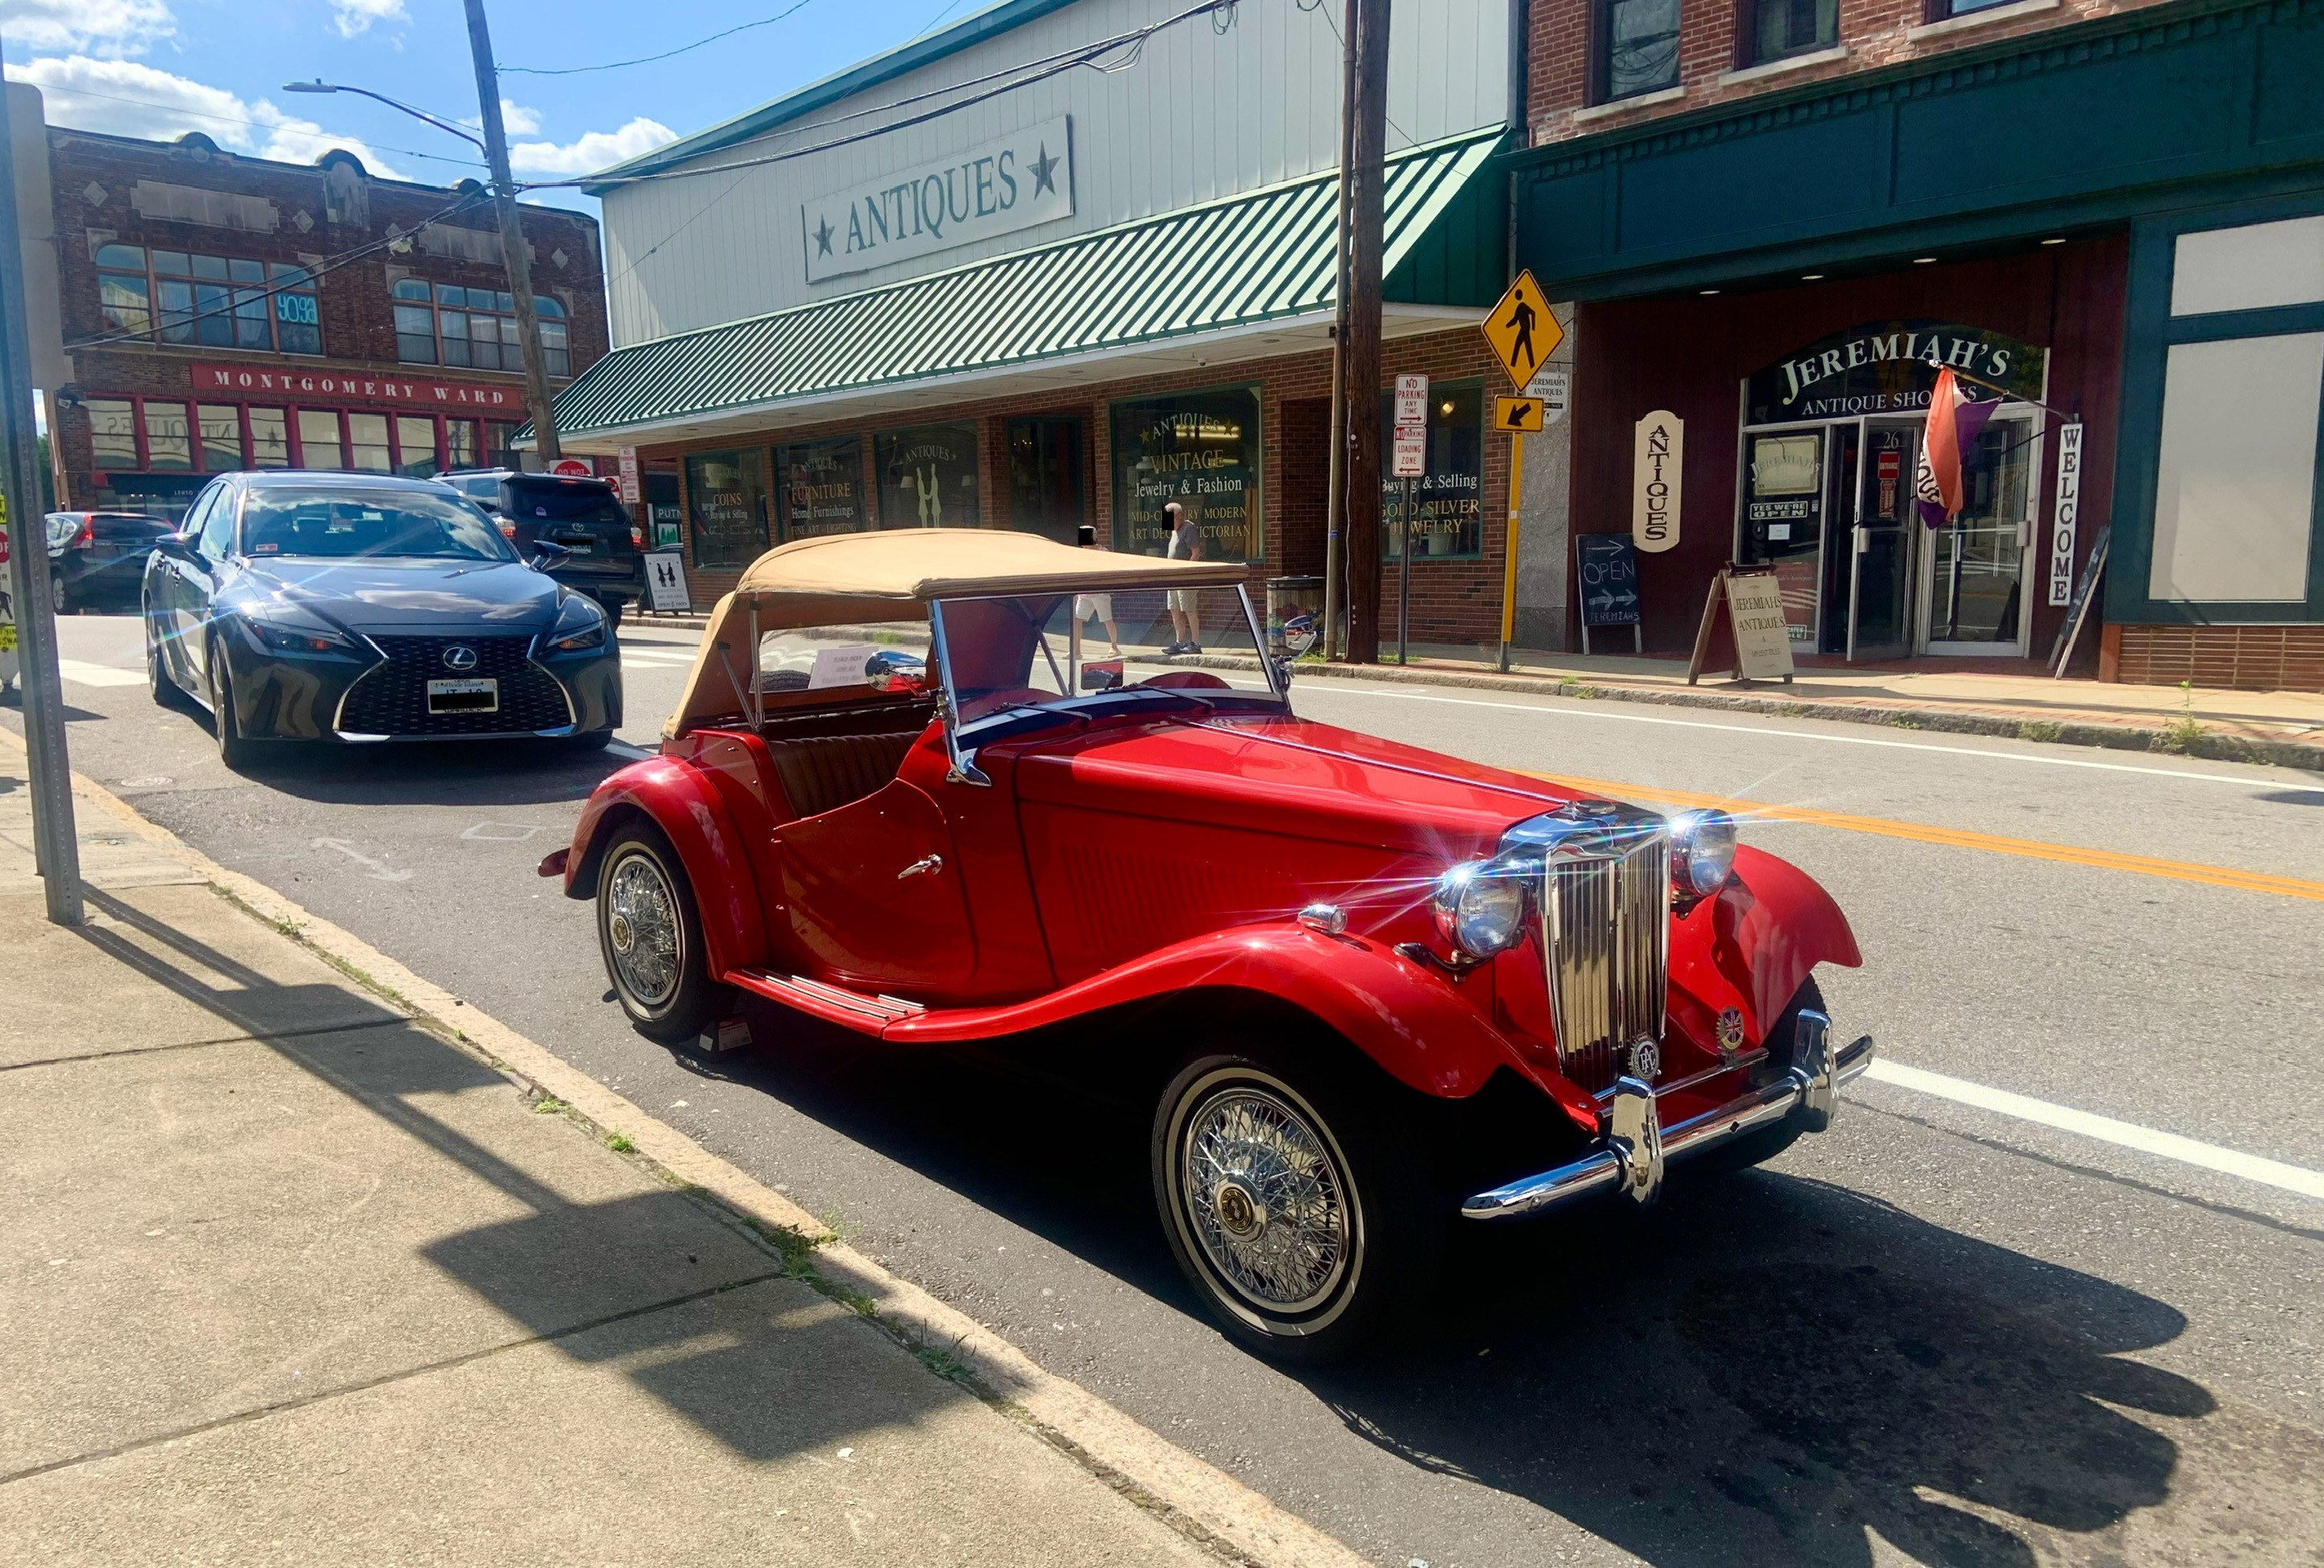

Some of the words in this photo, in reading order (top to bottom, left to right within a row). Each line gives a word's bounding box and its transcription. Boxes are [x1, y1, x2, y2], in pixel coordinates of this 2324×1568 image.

[845, 148, 1018, 255] ANTIQUES
[1781, 333, 2011, 405] JEREMIAH'S
[214, 370, 414, 399] MONTGOMERY
[433, 387, 504, 404] WARD
[1406, 379, 1418, 388] NO
[1533, 388, 1563, 396] ANTIQUES
[1398, 390, 1425, 399] PARKING
[1802, 394, 1887, 416] ANTIQUE
[1893, 386, 1977, 406] SHOES
[1152, 412, 1221, 441] ANTIQUES
[1398, 445, 1422, 453] LOADING
[1883, 432, 1899, 449] 26
[905, 445, 950, 464] ANTIQUES
[1149, 449, 1225, 474] VINTAGE
[1401, 457, 1417, 465] ZONE
[1135, 481, 1175, 498] Jewelry
[1181, 479, 1191, 495] &
[1197, 476, 1242, 493] Fashion
[1382, 478, 1418, 495] Buyig
[1423, 476, 1433, 489] &
[1438, 474, 1478, 489] Selling
[1645, 424, 1670, 540] ANTIQUES
[713, 492, 742, 507] COINS
[792, 483, 851, 500] FURNITURE
[813, 504, 855, 518] Furnishings
[1204, 506, 1248, 519] MODERN
[2053, 429, 2080, 600] WELCOME
[1130, 529, 1147, 540] ART
[1197, 525, 1251, 538] ICTORIAN
[1583, 558, 1635, 584] OPEN
[1739, 616, 1787, 632] ANTIQUES
